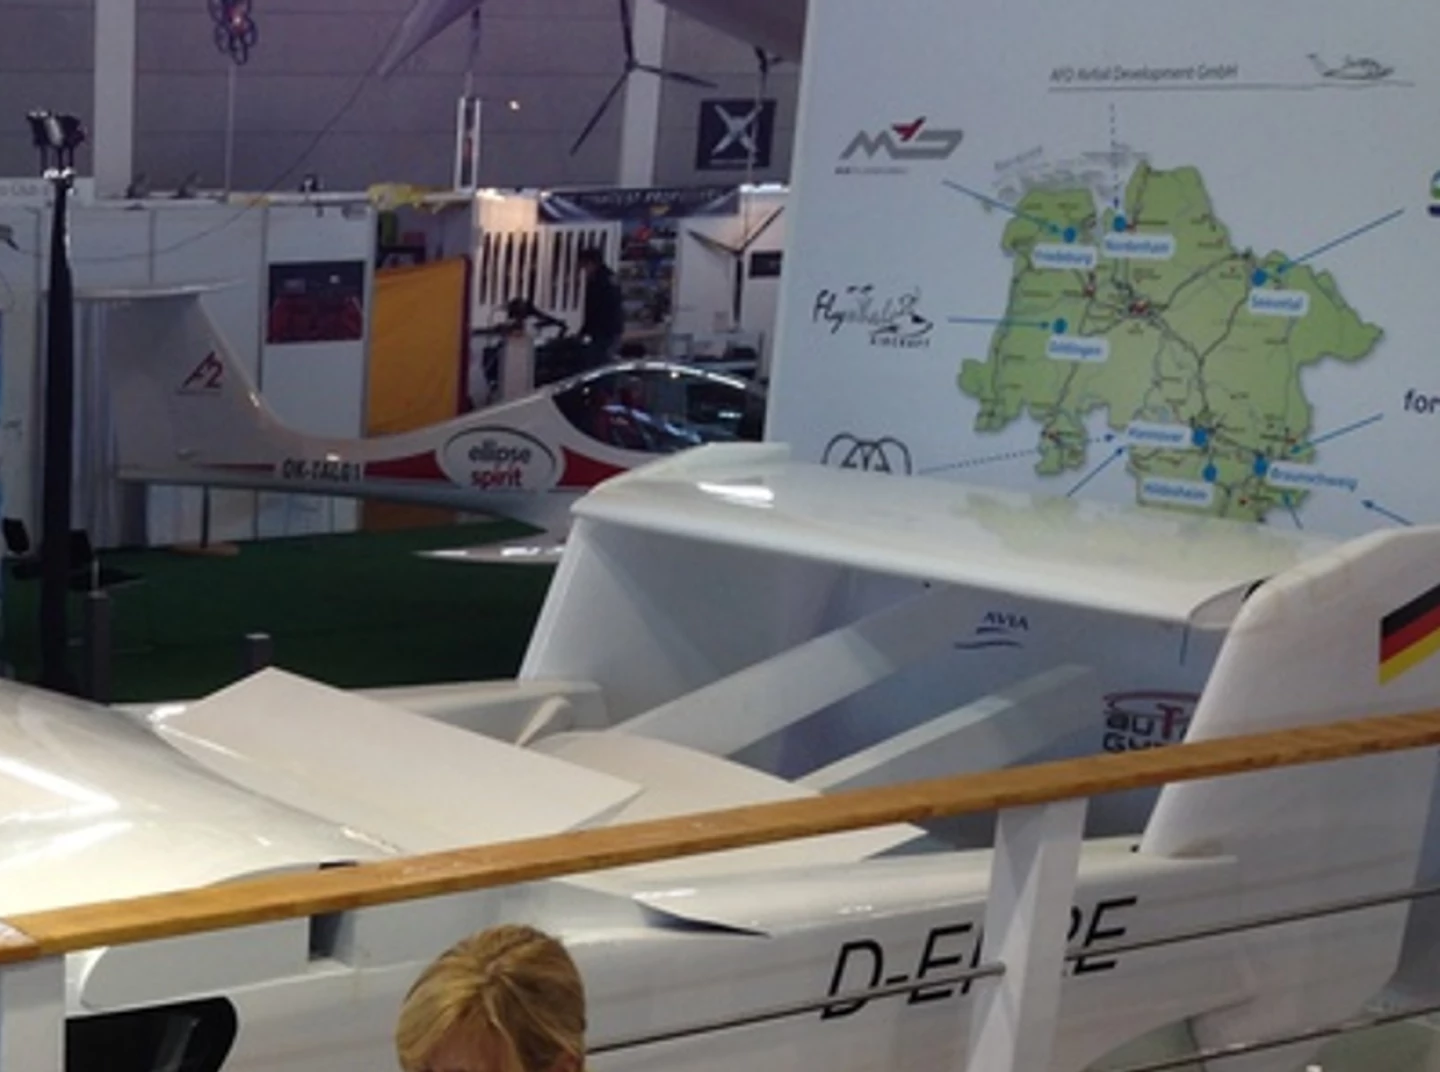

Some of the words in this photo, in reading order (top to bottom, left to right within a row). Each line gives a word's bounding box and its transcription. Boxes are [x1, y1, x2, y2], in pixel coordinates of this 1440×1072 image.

[467, 438, 532, 467] ellipse
[470, 465, 523, 490] spirit
[983, 611, 1028, 631] AVIA
